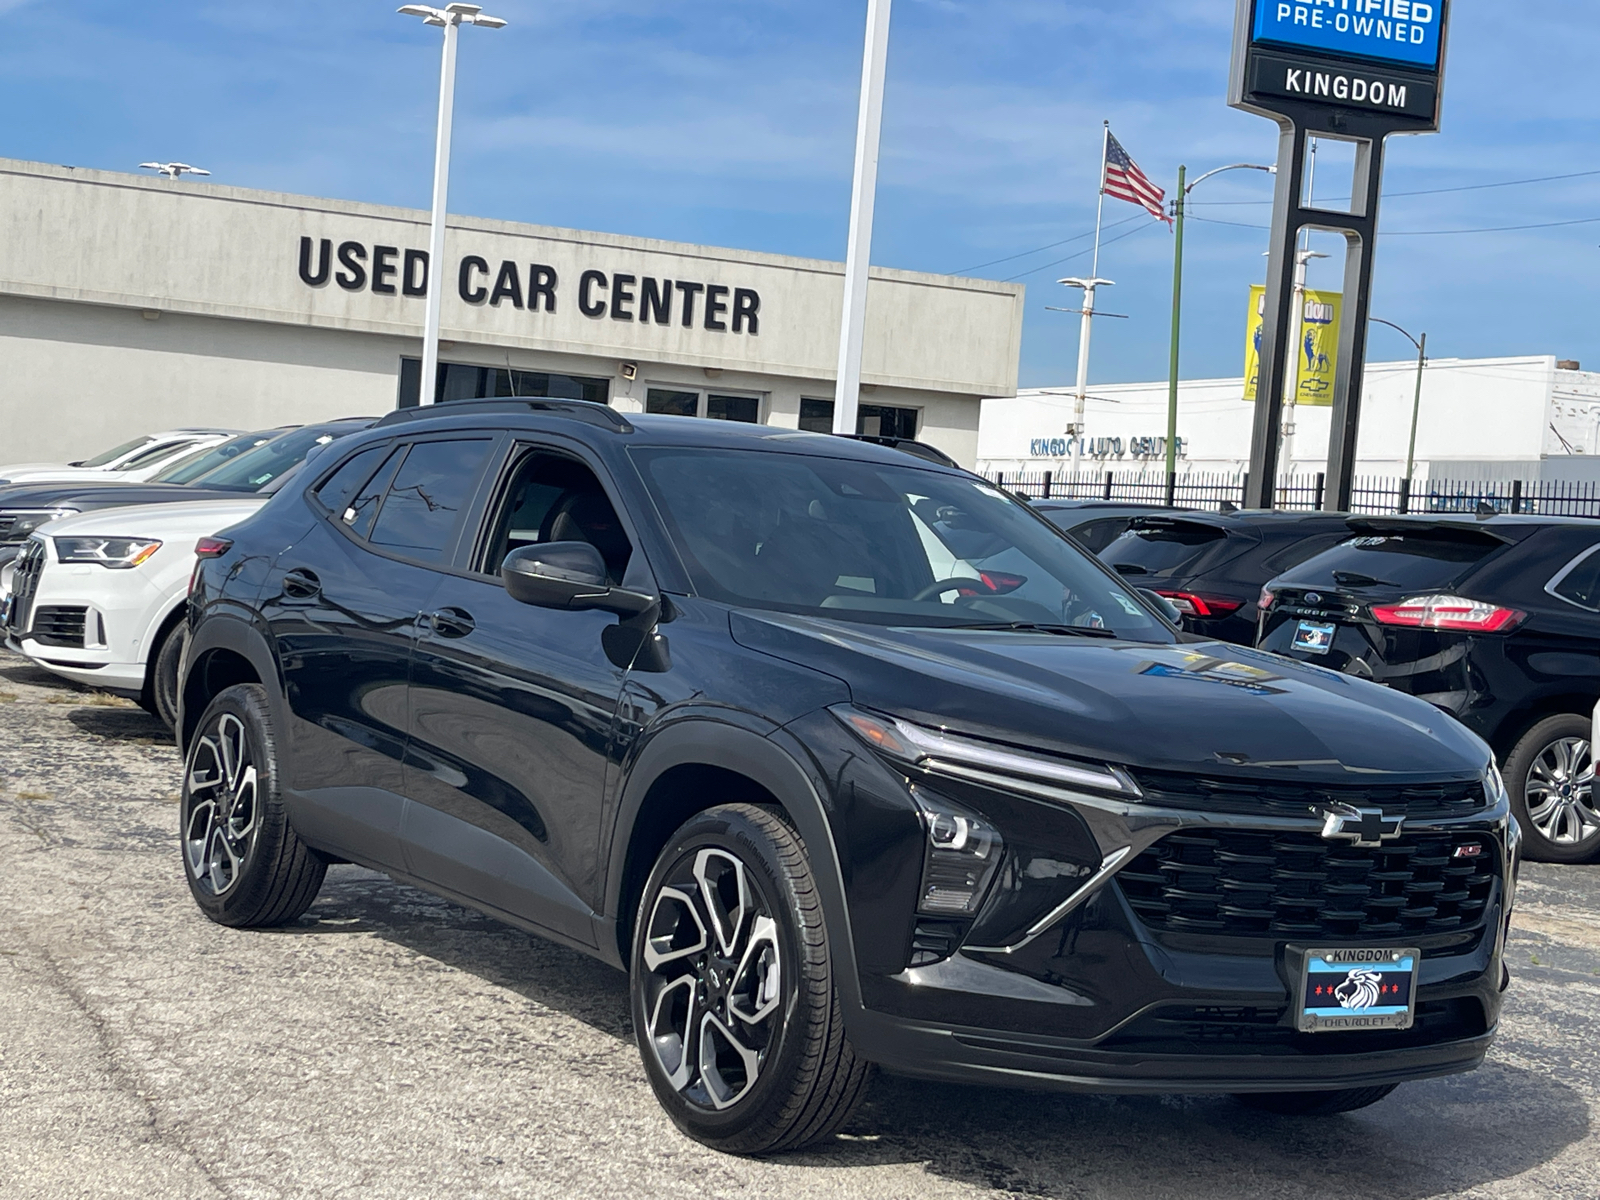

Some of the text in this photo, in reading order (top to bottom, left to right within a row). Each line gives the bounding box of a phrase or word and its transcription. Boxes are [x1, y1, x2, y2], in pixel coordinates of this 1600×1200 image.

[1277, 3, 1425, 45] PRE-OWNED
[1286, 68, 1406, 108] KINGDOM
[299, 236, 760, 335] USED CAR CENTER
[1088, 437, 1123, 455] AUTO
[1130, 437, 1182, 455] CENTR
[1457, 845, 1482, 857] RS
[1333, 950, 1393, 961] KINGDOM
[1324, 1017, 1384, 1028] CHEVROLET
